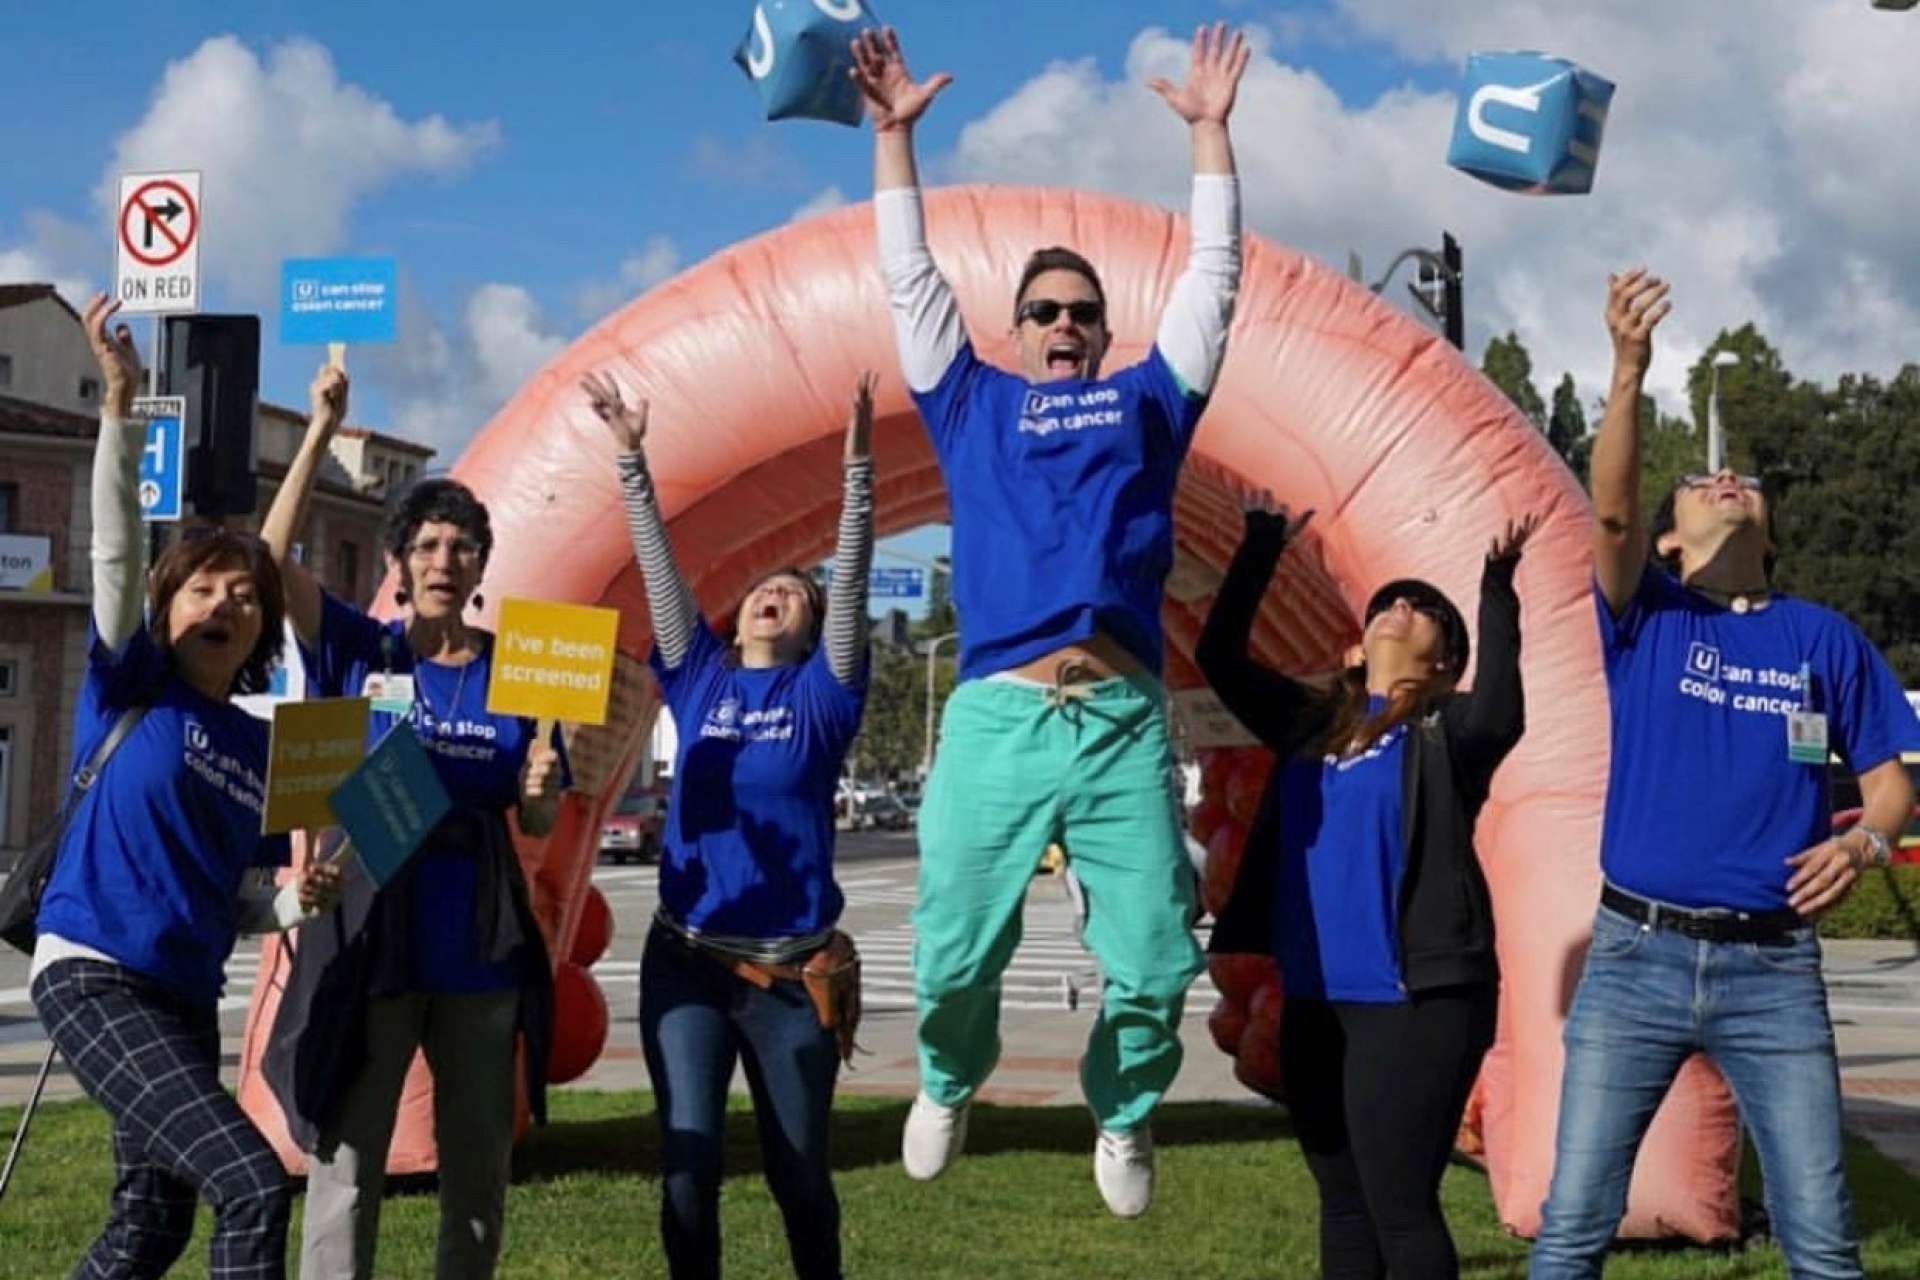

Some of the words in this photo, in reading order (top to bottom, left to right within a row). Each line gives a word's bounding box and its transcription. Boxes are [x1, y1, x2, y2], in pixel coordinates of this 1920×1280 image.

[122, 280, 148, 301] ON
[154, 276, 192, 300] RED
[299, 283, 313, 298] U
[1079, 389, 1119, 406] stop
[1063, 411, 1123, 430] cancer
[506, 633, 544, 654] I've
[551, 637, 606, 661] been
[1695, 650, 1714, 671] U
[501, 662, 602, 691] screened
[1732, 694, 1802, 716] cancer
[192, 728, 209, 750] U
[455, 718, 497, 740] stop
